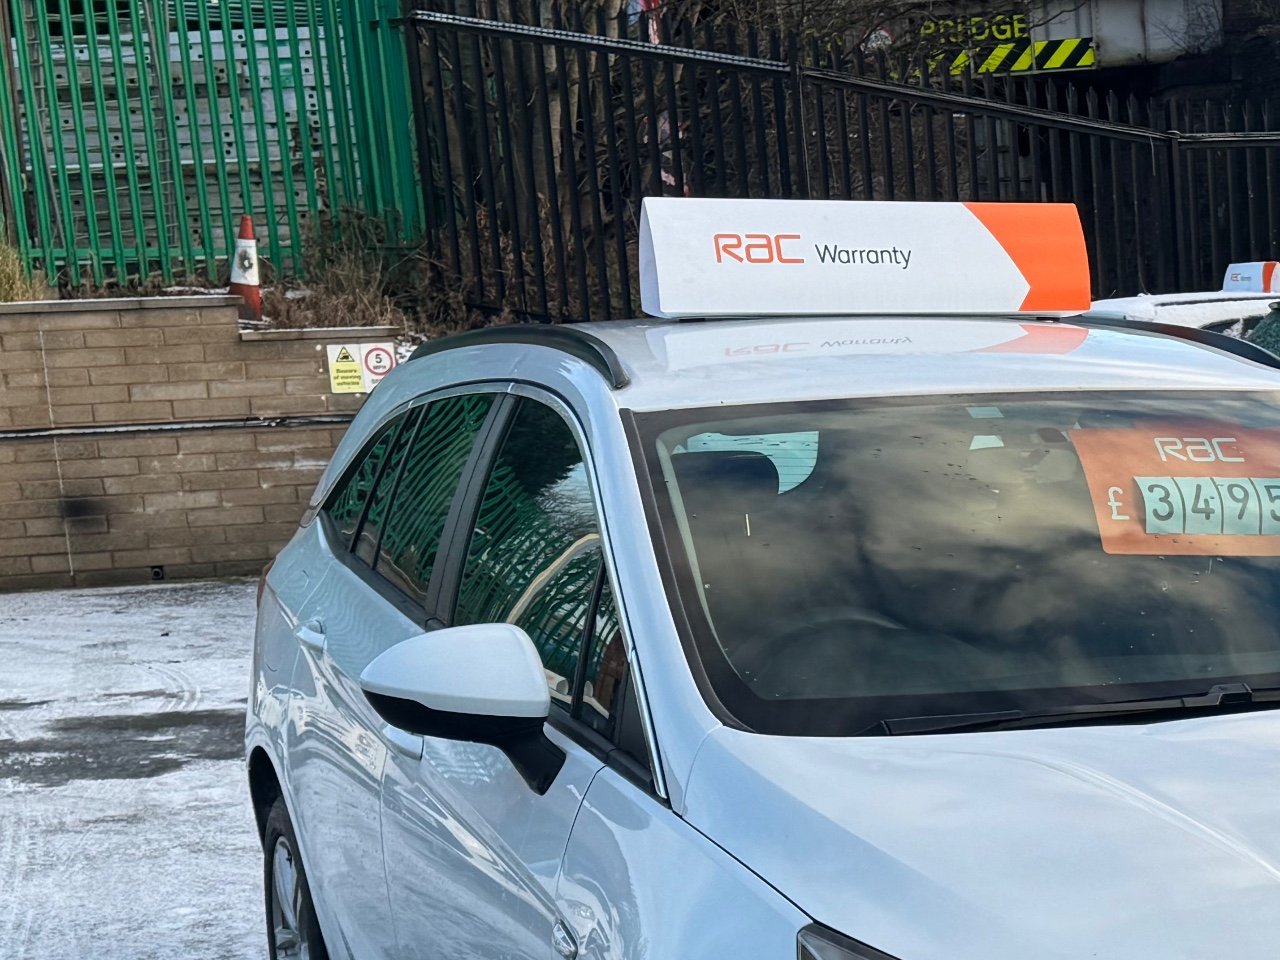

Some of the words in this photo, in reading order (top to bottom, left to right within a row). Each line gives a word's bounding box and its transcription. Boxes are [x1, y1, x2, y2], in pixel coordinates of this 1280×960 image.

[713, 233, 805, 264] RAC
[814, 243, 912, 270] Warranty
[375, 353, 382, 364] 5
